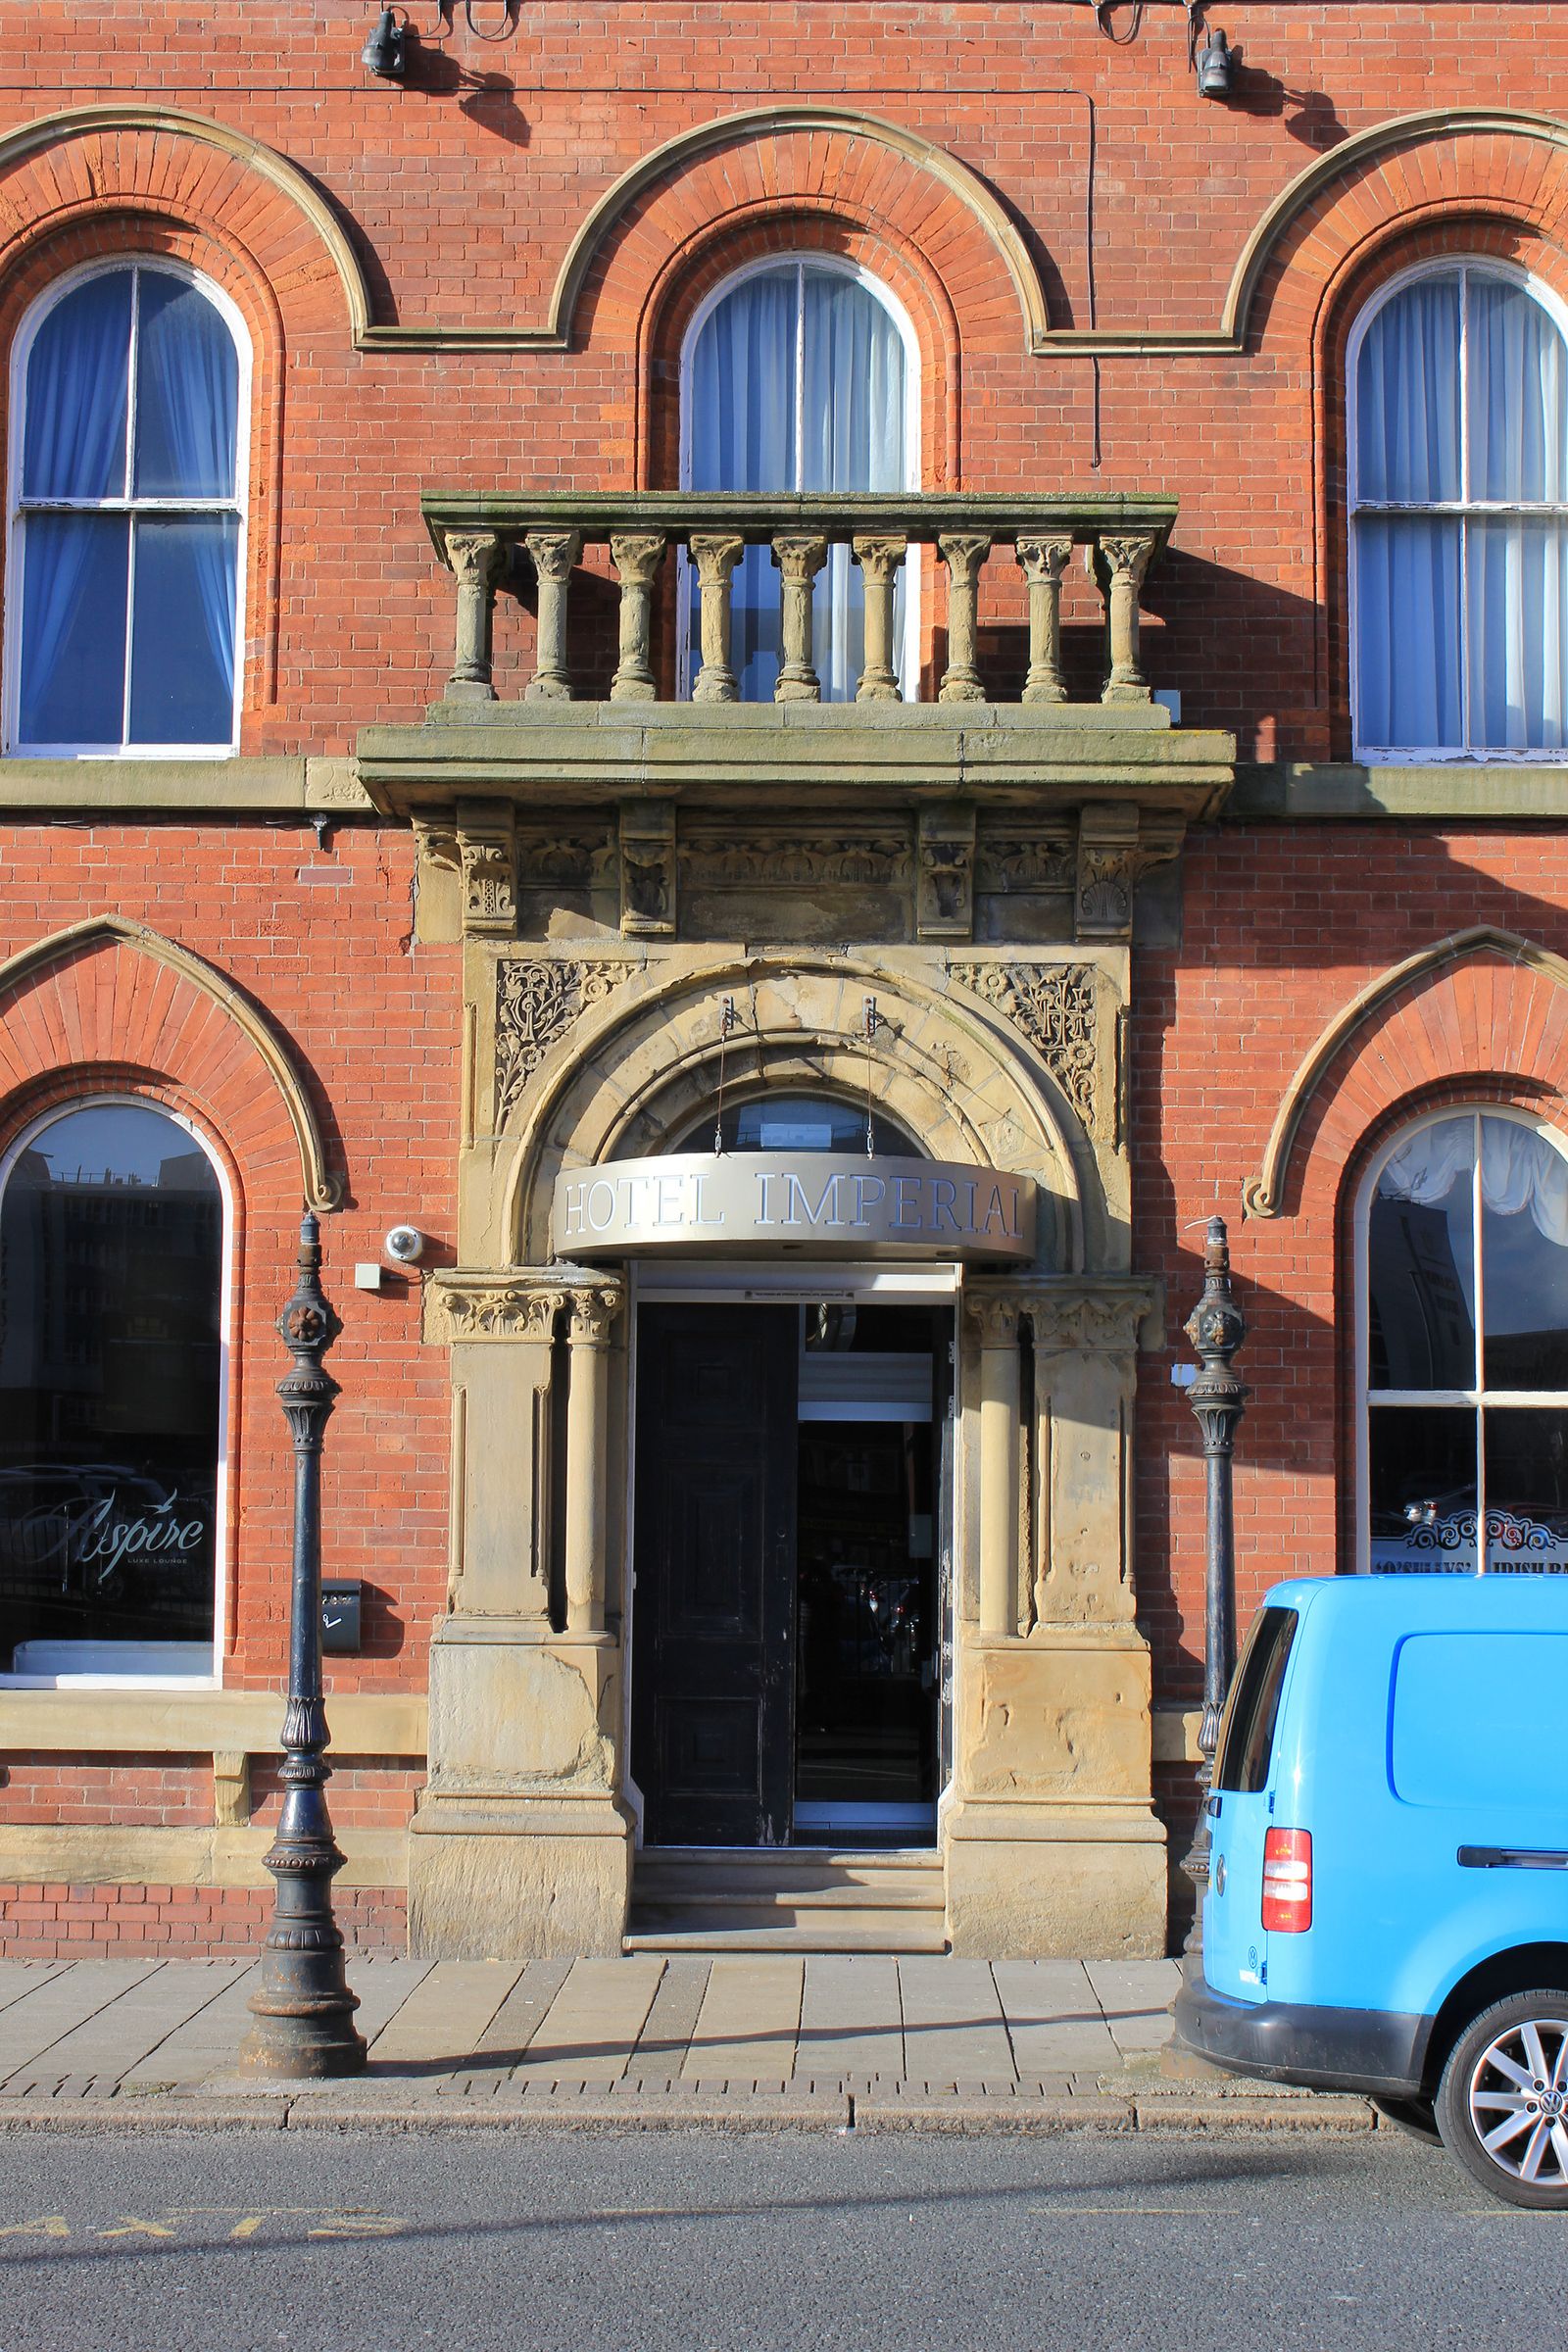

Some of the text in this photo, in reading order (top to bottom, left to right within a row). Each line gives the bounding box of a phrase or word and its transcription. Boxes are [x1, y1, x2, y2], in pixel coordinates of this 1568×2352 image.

[564, 1172, 1025, 1240] HOTEL IMPERIAL
[14, 1487, 204, 1582] Aspire
